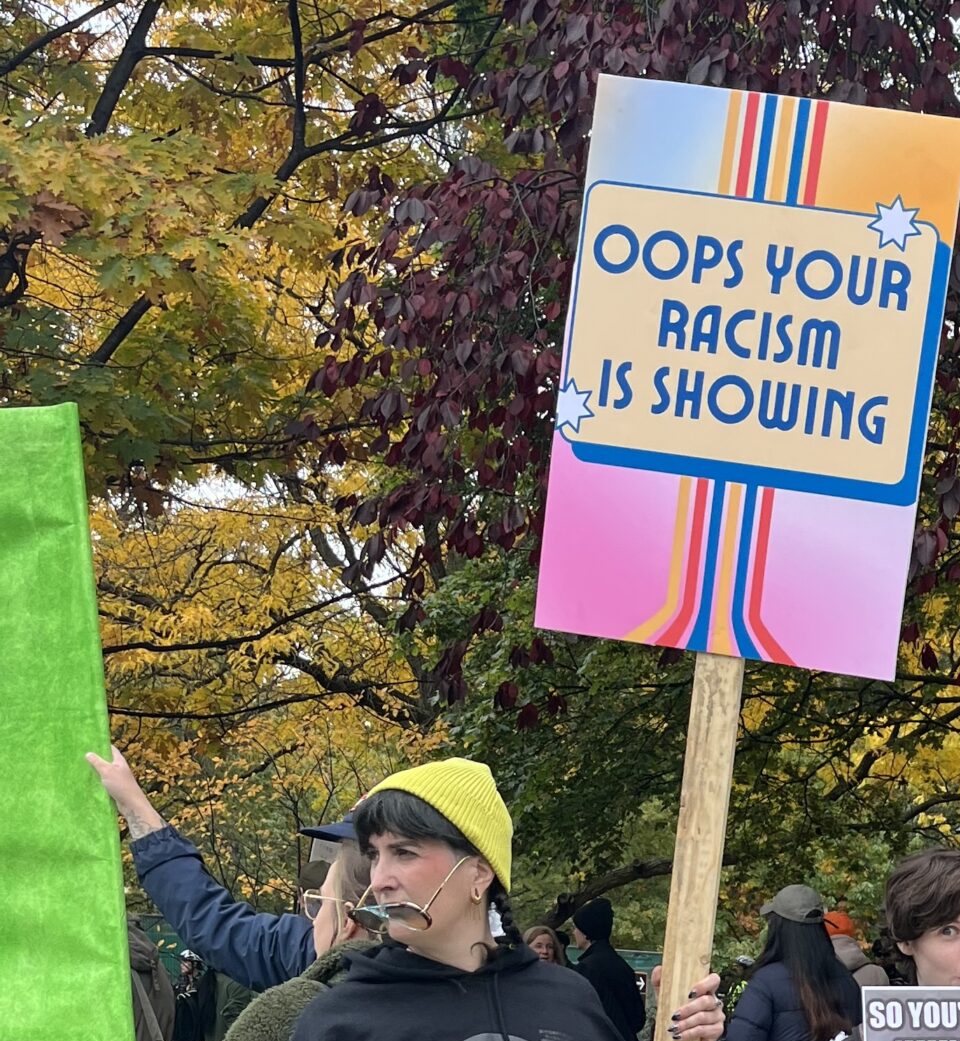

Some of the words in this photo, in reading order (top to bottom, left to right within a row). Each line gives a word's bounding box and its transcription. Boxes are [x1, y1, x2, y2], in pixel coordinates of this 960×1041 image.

[593, 223, 744, 289] OOPS
[766, 243, 912, 311] YOUR
[657, 299, 842, 371] RACISM
[598, 358, 633, 410] IS
[651, 366, 889, 445] SHOWING
[869, 1001, 904, 1029] SO
